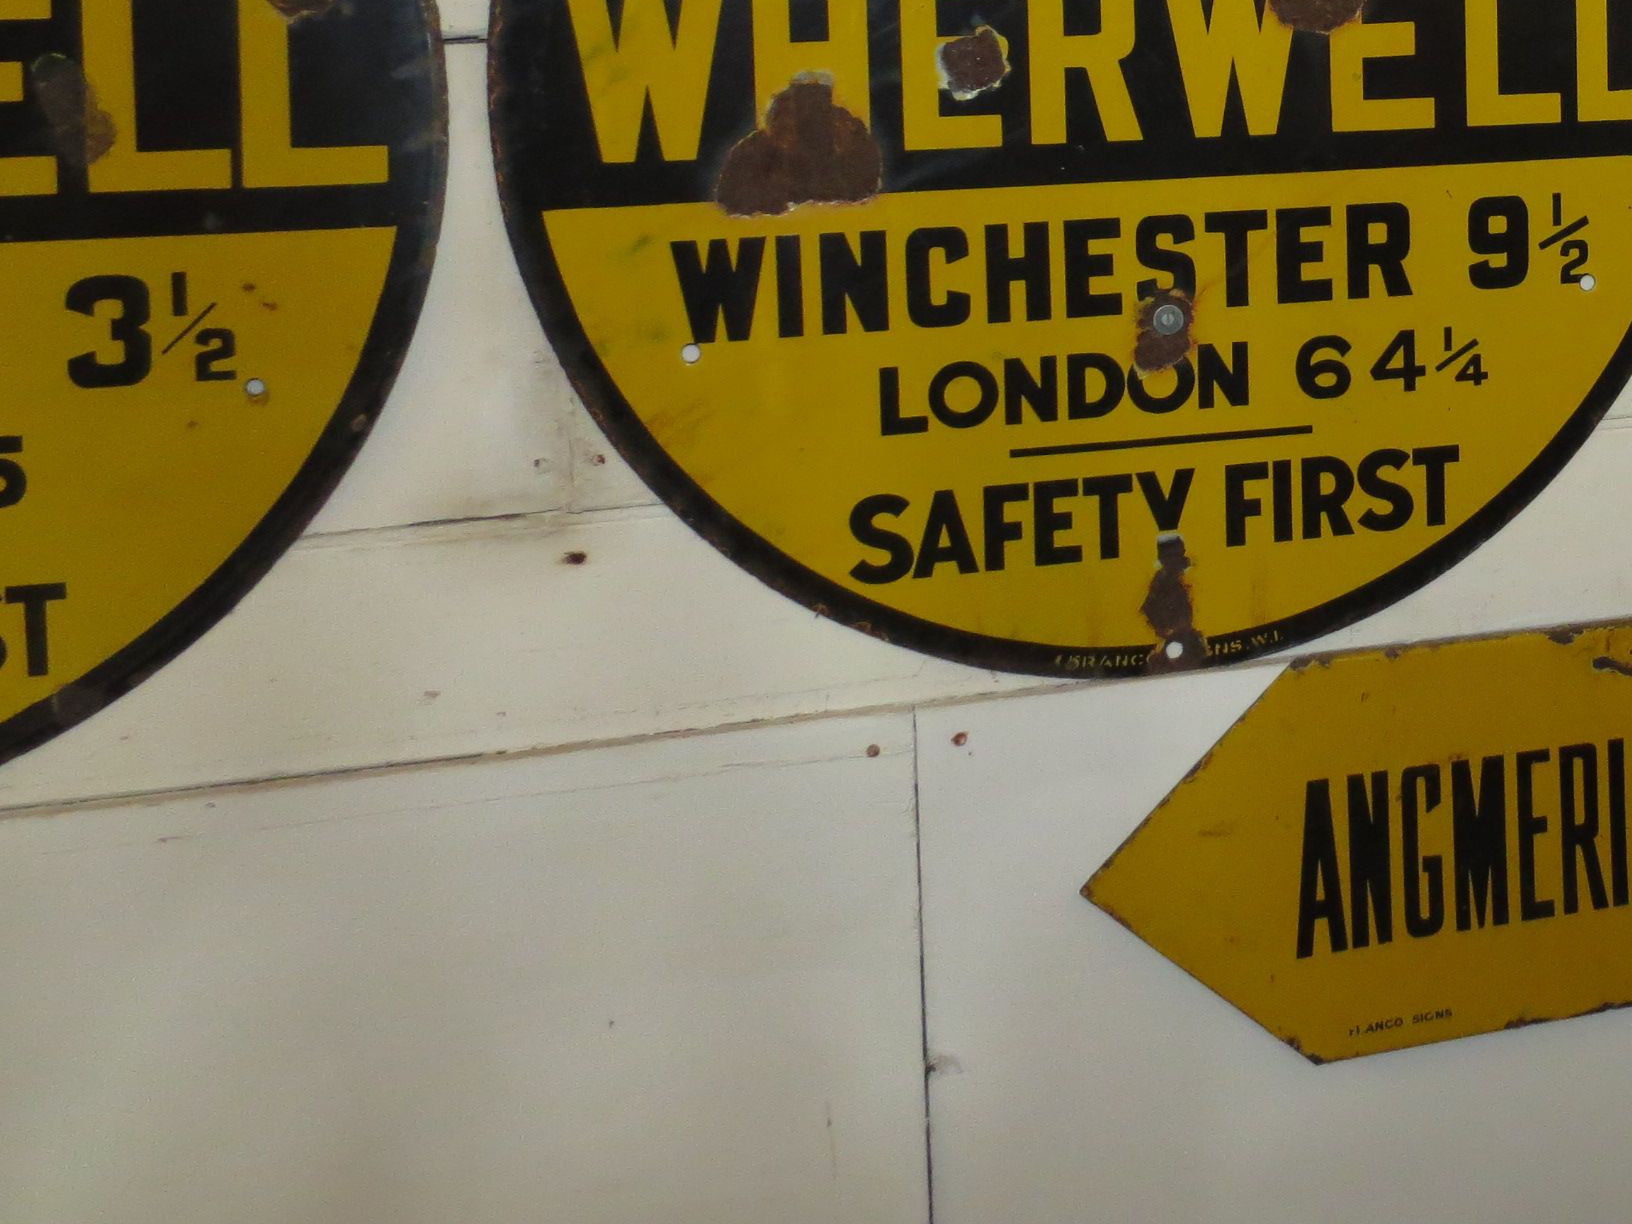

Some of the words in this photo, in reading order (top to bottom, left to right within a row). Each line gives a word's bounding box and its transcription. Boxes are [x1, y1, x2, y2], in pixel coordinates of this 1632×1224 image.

[672, 200, 1410, 344] WINCHESTER
[879, 343, 1249, 437] LONDON
[849, 467, 1195, 585] SAFETY
[1225, 445, 1460, 549] FIRST
[1412, 1008, 1452, 1024] SIGNS
